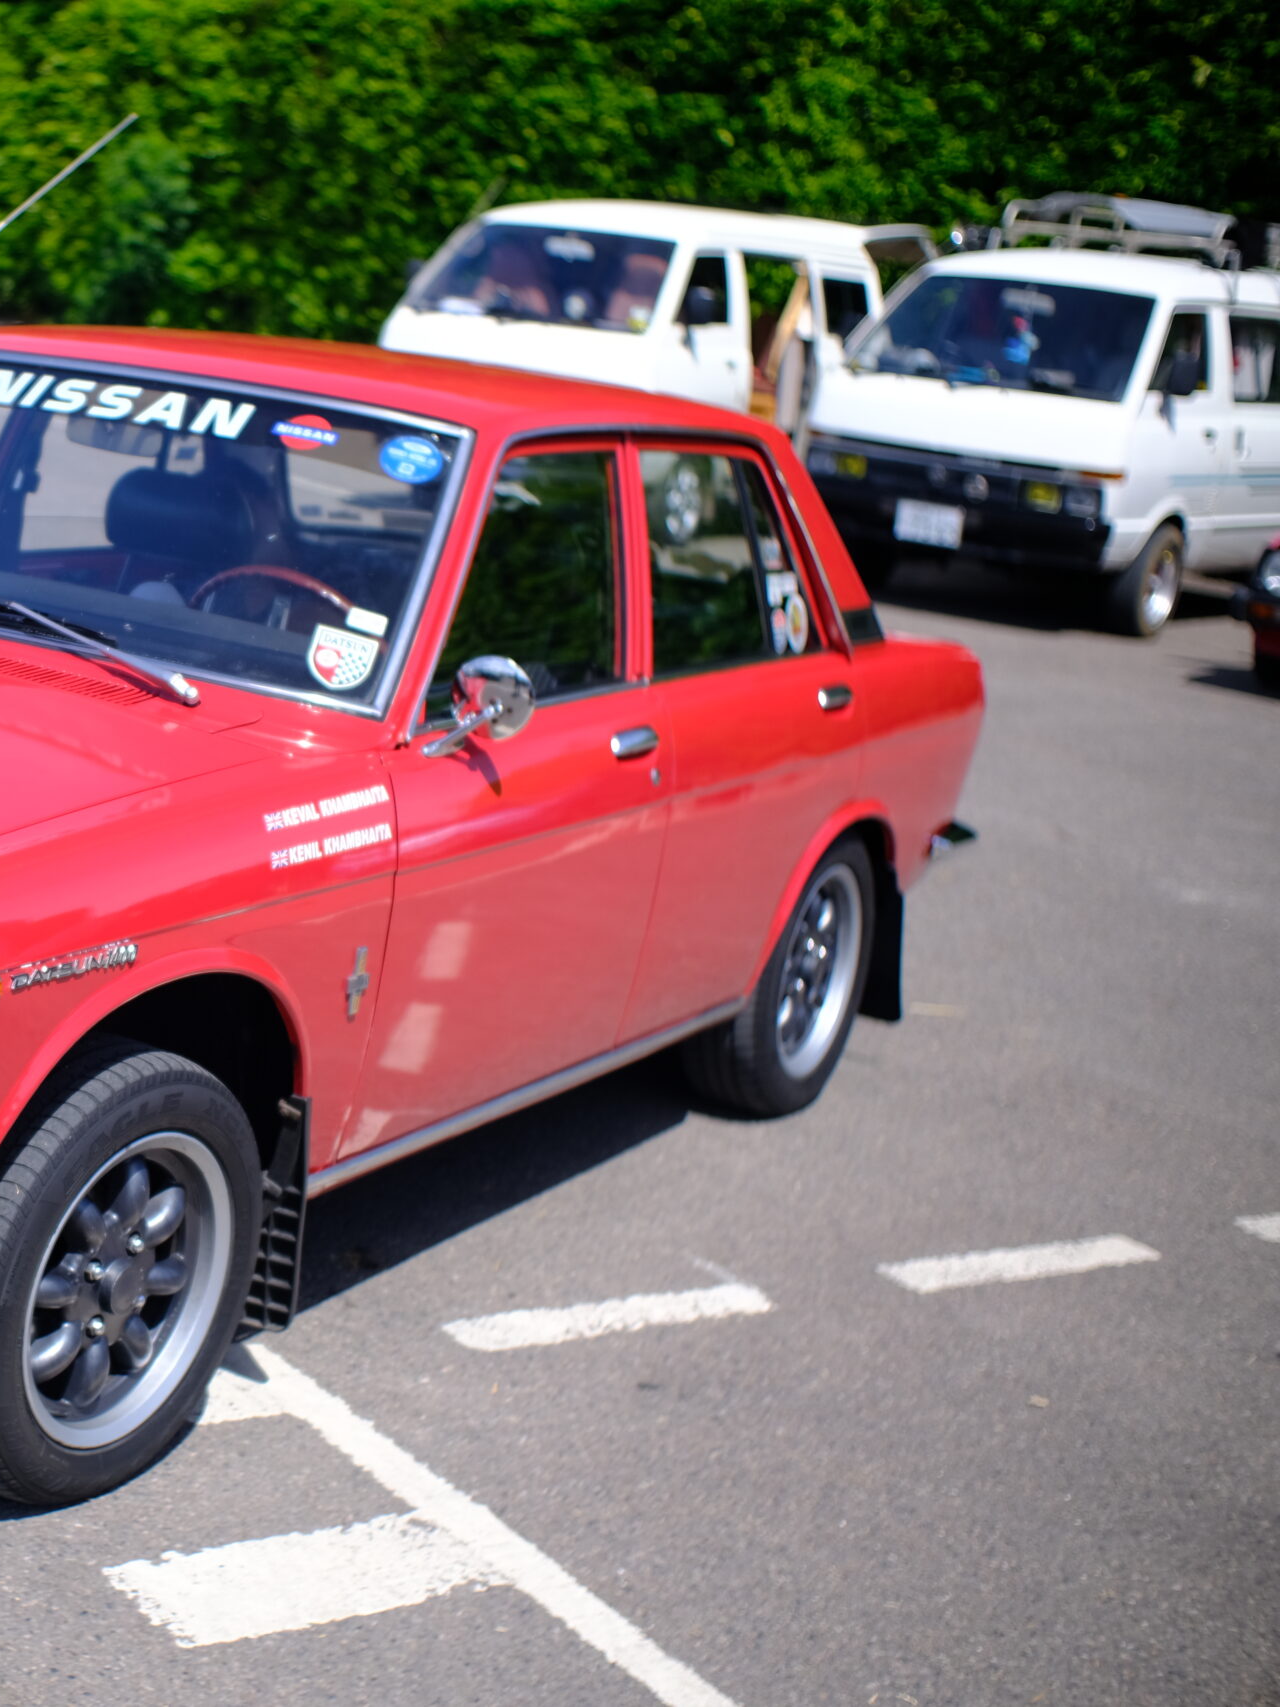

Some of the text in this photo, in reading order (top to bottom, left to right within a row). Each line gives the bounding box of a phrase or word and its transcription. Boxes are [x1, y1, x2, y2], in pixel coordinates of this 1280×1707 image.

[275, 424, 336, 443] NISSAN
[323, 633, 368, 654] DATSUN
[282, 803, 320, 826] KEVAL
[289, 841, 322, 864] KENIL
[11, 954, 104, 990] DATSUN
